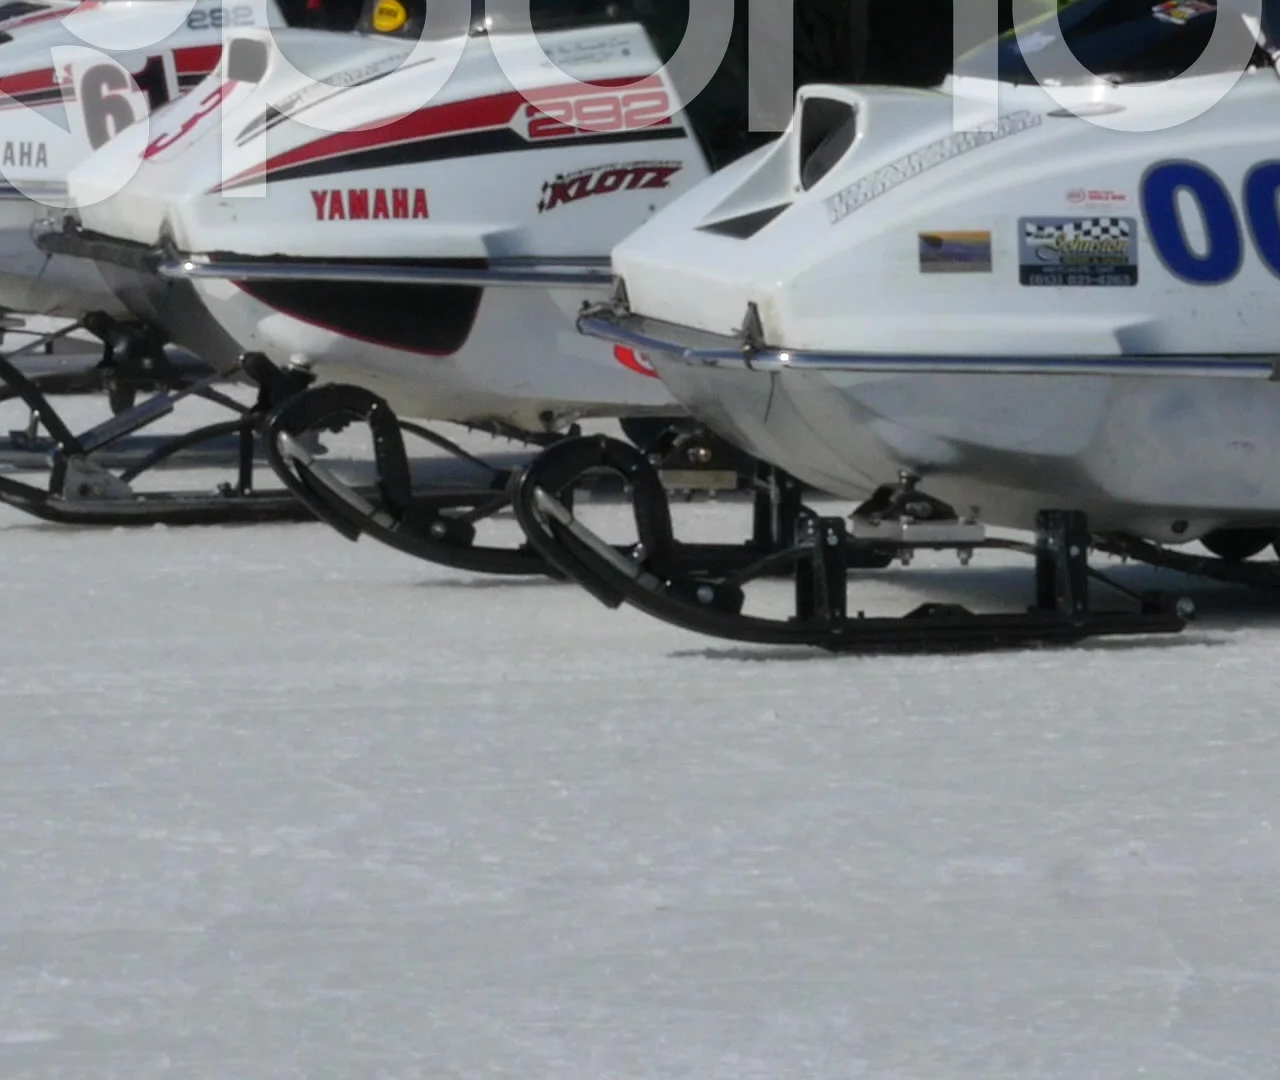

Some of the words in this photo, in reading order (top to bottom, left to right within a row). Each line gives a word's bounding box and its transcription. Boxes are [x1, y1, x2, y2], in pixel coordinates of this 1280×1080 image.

[526, 91, 673, 138] 292
[312, 188, 430, 220] YAMAHA
[545, 167, 683, 211] KLOTZ
